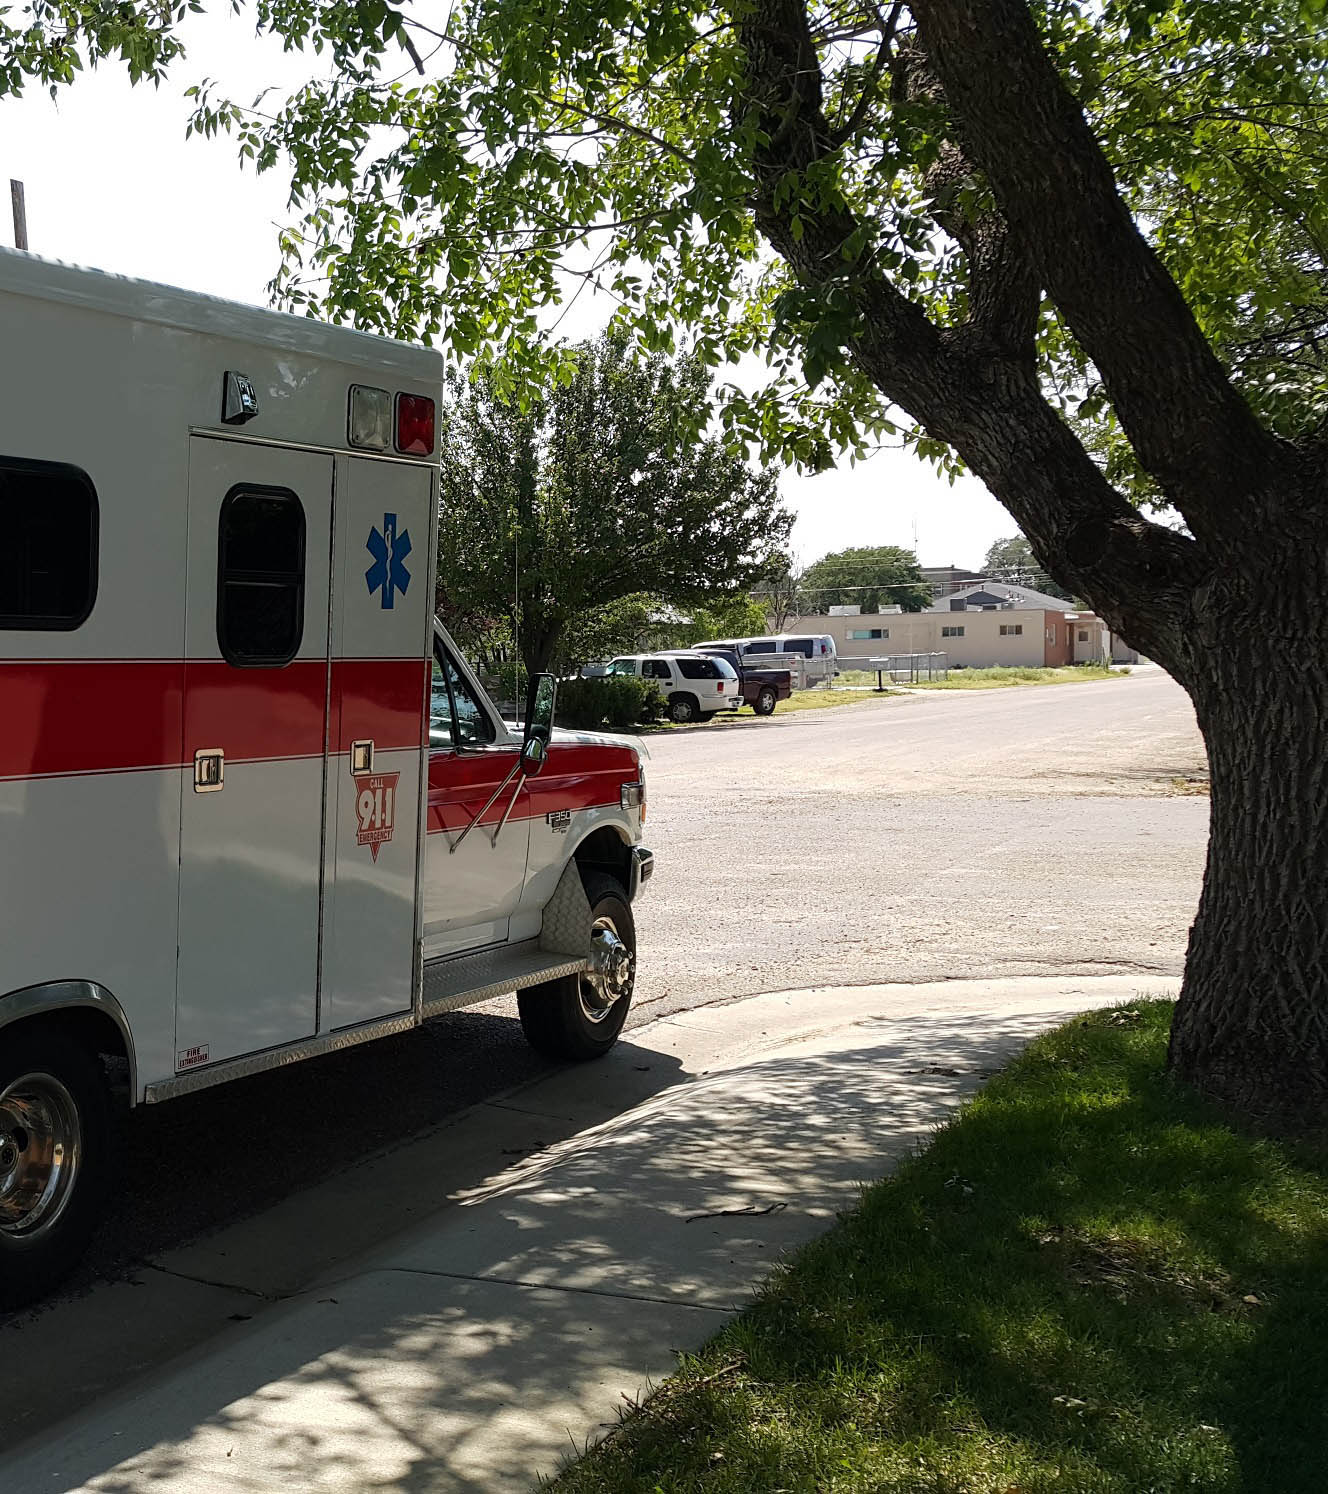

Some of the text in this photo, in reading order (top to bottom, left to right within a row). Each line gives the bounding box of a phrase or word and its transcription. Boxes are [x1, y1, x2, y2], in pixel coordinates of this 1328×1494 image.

[369, 777, 384, 789] CALL
[548, 810, 572, 824] F350
[359, 831, 391, 843] EMERGENCY
[186, 1047, 201, 1058] FIRE
[179, 1053, 208, 1068] EXTINGUISHER
